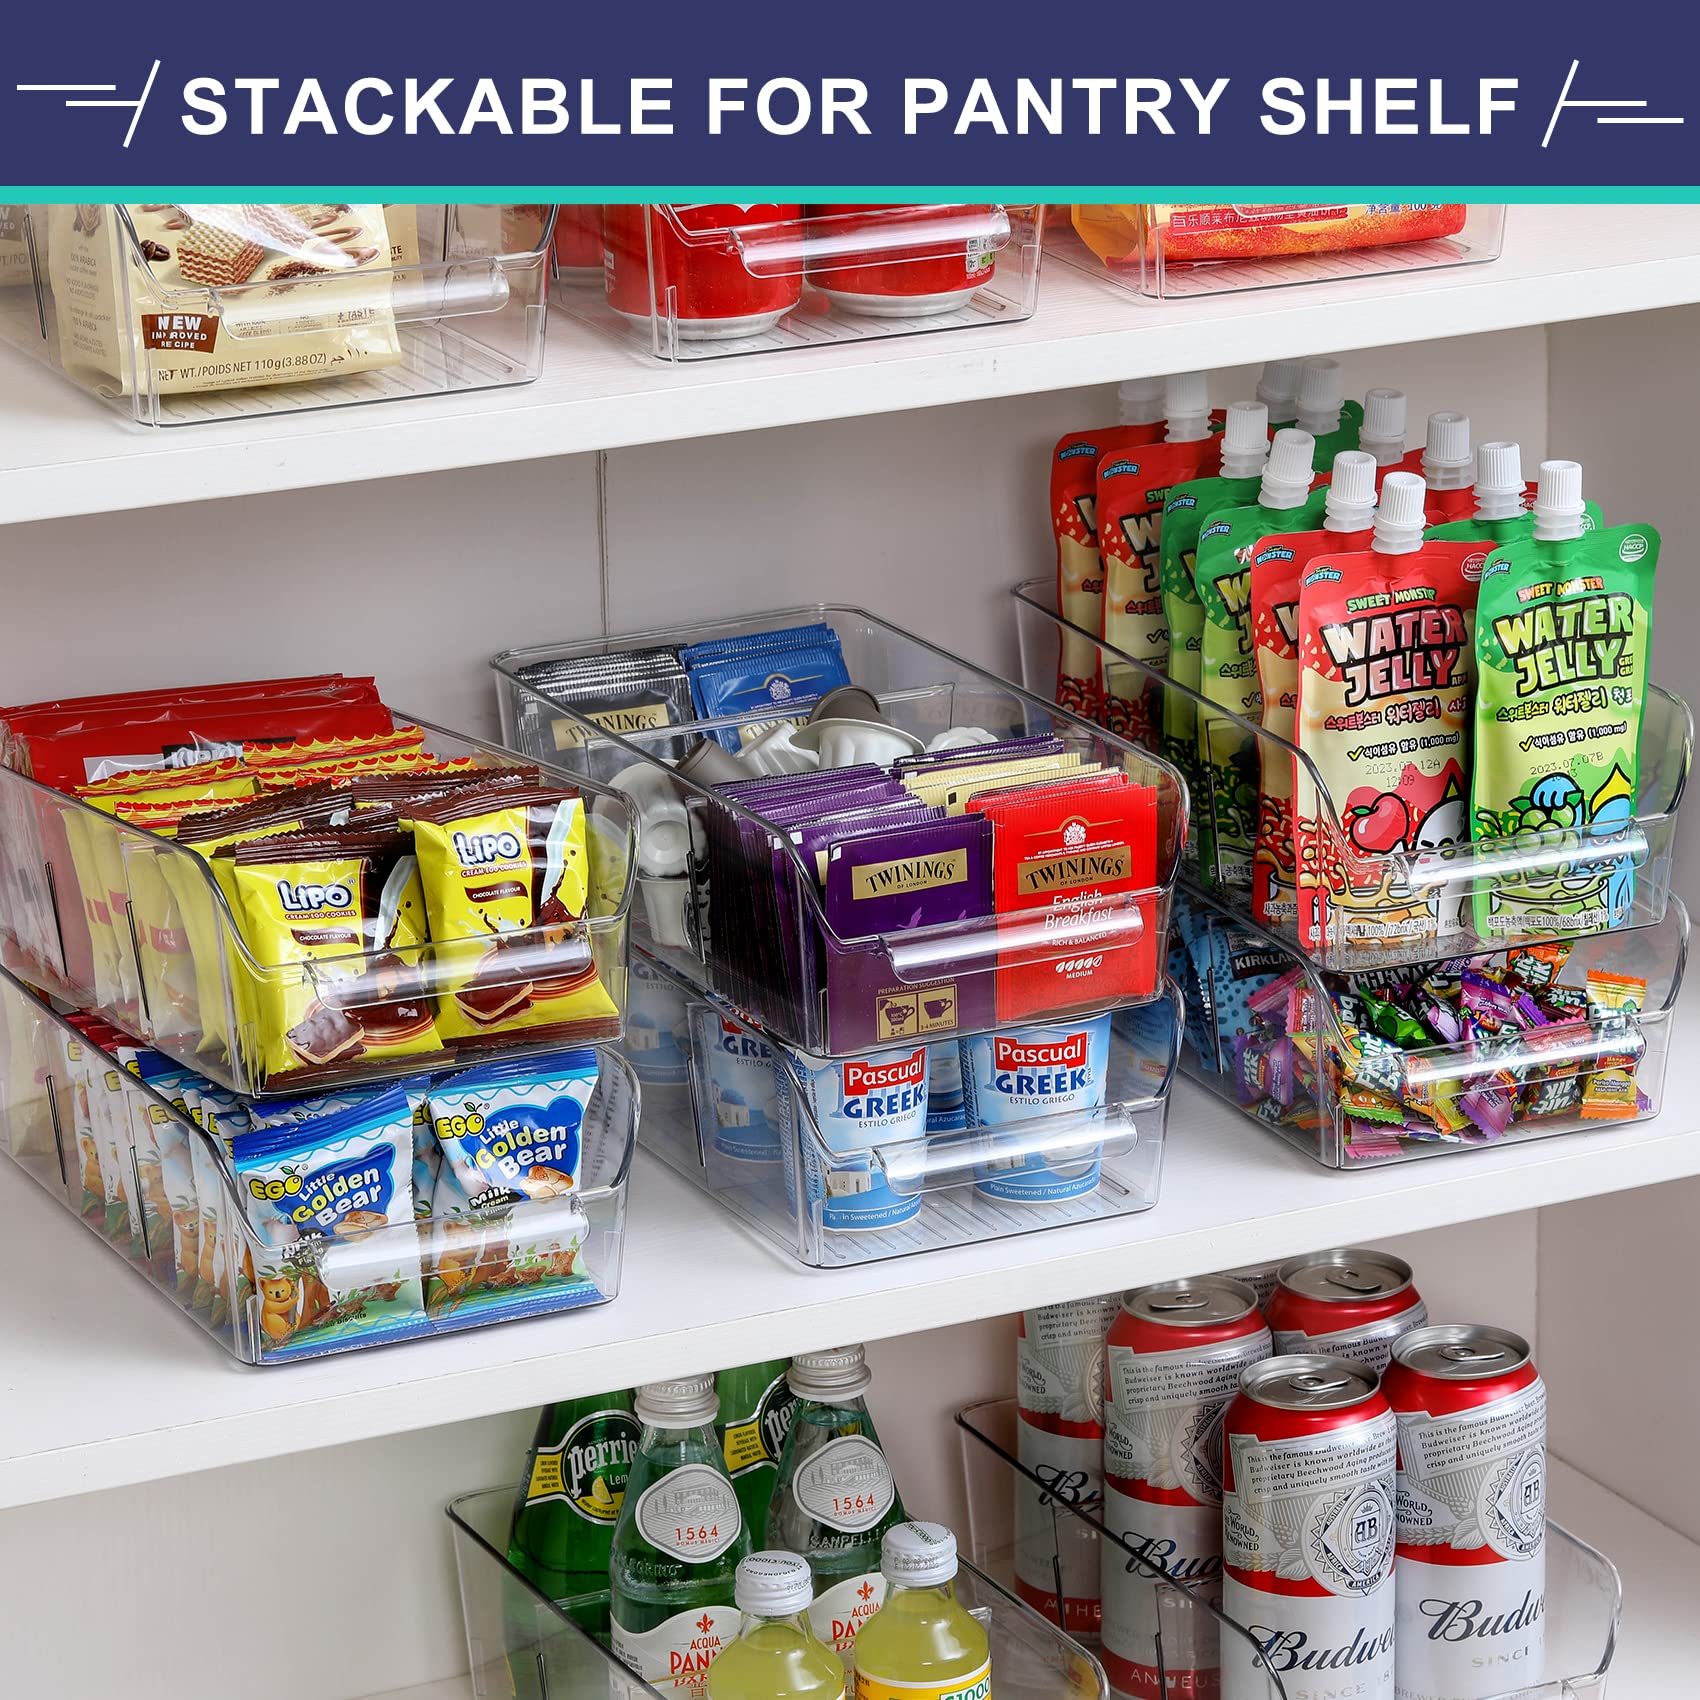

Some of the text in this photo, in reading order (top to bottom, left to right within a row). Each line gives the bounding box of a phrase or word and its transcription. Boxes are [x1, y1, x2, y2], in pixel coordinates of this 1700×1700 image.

[157, 315, 202, 331] NEW
[151, 330, 208, 342] IMPROVED
[160, 340, 196, 349] RECIPE
[232, 360, 253, 374] NET
[1623, 543, 1644, 552] HACCP
[1255, 548, 1296, 570] MONSTER
[1517, 576, 1605, 603] SWEET MONSTER
[1346, 593, 1392, 613] SWEET
[1494, 593, 1633, 657] WATER
[1321, 606, 1468, 667] WATER
[1345, 648, 1460, 706] JELLY
[1518, 637, 1626, 697] JELLY
[1325, 695, 1442, 731] 스위트몬스터 워터젤리
[1496, 686, 1609, 721] 스위트몬스터 워터젤리
[1364, 742, 1398, 760] 식이섬유
[1399, 738, 1419, 753] 함유
[1420, 735, 1445, 749] (1,000
[1534, 732, 1566, 749] 식이섬유
[1567, 728, 1586, 743] 함유
[1588, 724, 1614, 739] (1,000
[461, 861, 528, 877] CREAM EGG COOKIES
[866, 859, 955, 894] TWININGS
[1025, 856, 1125, 890] TWININGS
[896, 879, 928, 890] OF LONDON
[1069, 876, 1094, 885] LONDON
[472, 886, 521, 900] CHOCOLATE FLAVOUR
[1053, 889, 1104, 913] English
[285, 909, 357, 921] CREAM EGG COOKIES
[1044, 906, 1115, 931] Breakfast
[299, 932, 352, 942] CHOCOLATE FLAVOUR
[1052, 931, 1108, 947] RICH & BALANCED
[1066, 969, 1094, 979] MEDIUM
[878, 977, 955, 995] PREPARATION SUGGESTION
[929, 1019, 954, 1028] MINUTES
[999, 1037, 1082, 1064] Pascual
[849, 1054, 924, 1088] Pascual
[995, 1067, 1087, 1096] GREEK
[843, 1083, 925, 1119] GREEK
[1009, 1093, 1076, 1105] ESTILO GRIEGO
[435, 1113, 485, 1140] EGO
[858, 1109, 917, 1129] ESTILO GRIEGO
[480, 1119, 520, 1145] Little
[475, 1125, 568, 1170] Golden
[497, 1143, 568, 1180] Bear
[249, 1174, 303, 1202] EGO
[292, 1167, 380, 1224] Golden
[299, 1173, 336, 1202] Little
[470, 1186, 511, 1207] Milk
[1006, 1184, 1043, 1196] Sweetened
[1047, 1183, 1072, 1195] Natural
[315, 1184, 382, 1227] Bear
[481, 1195, 510, 1210] Cream
[851, 1202, 911, 1221] Sweetened Natural
[1041, 1330, 1072, 1341] crisp and
[1331, 1340, 1362, 1354] famous
[1352, 1345, 1381, 1358] known
[1123, 1366, 1135, 1375] This
[1135, 1366, 1142, 1374] is
[1154, 1363, 1184, 1374] famous
[1124, 1360, 1248, 1385] Budweiser is known worldwide
[1126, 1372, 1238, 1396] proprietary Beechwood Aging
[1128, 1383, 1229, 1405] crisp and uniquely smooth
[1418, 1418, 1489, 1441] This is the famous
[1421, 1408, 1540, 1449] Budweiser is known worldwide
[1423, 1421, 1534, 1460] proprietary Beechwood Aging
[1248, 1449, 1314, 1465] This the famous
[1250, 1443, 1377, 1475] Budweiser is known worldwide
[1426, 1435, 1528, 1470] crisp and uniquely smooth
[1251, 1455, 1368, 1485] proprietary Beechwood Aging
[1254, 1463, 1377, 1495] crisp and uniquely smooth taste
[832, 1493, 875, 1512] 1564
[676, 1525, 719, 1541] 1564
[1354, 1517, 1378, 1544] AB
[1351, 1571, 1382, 1588] AMERICA
[851, 1602, 881, 1619] ACQUA
[689, 1635, 722, 1651] ACQUA
[1295, 1683, 1367, 1700] SINCE
